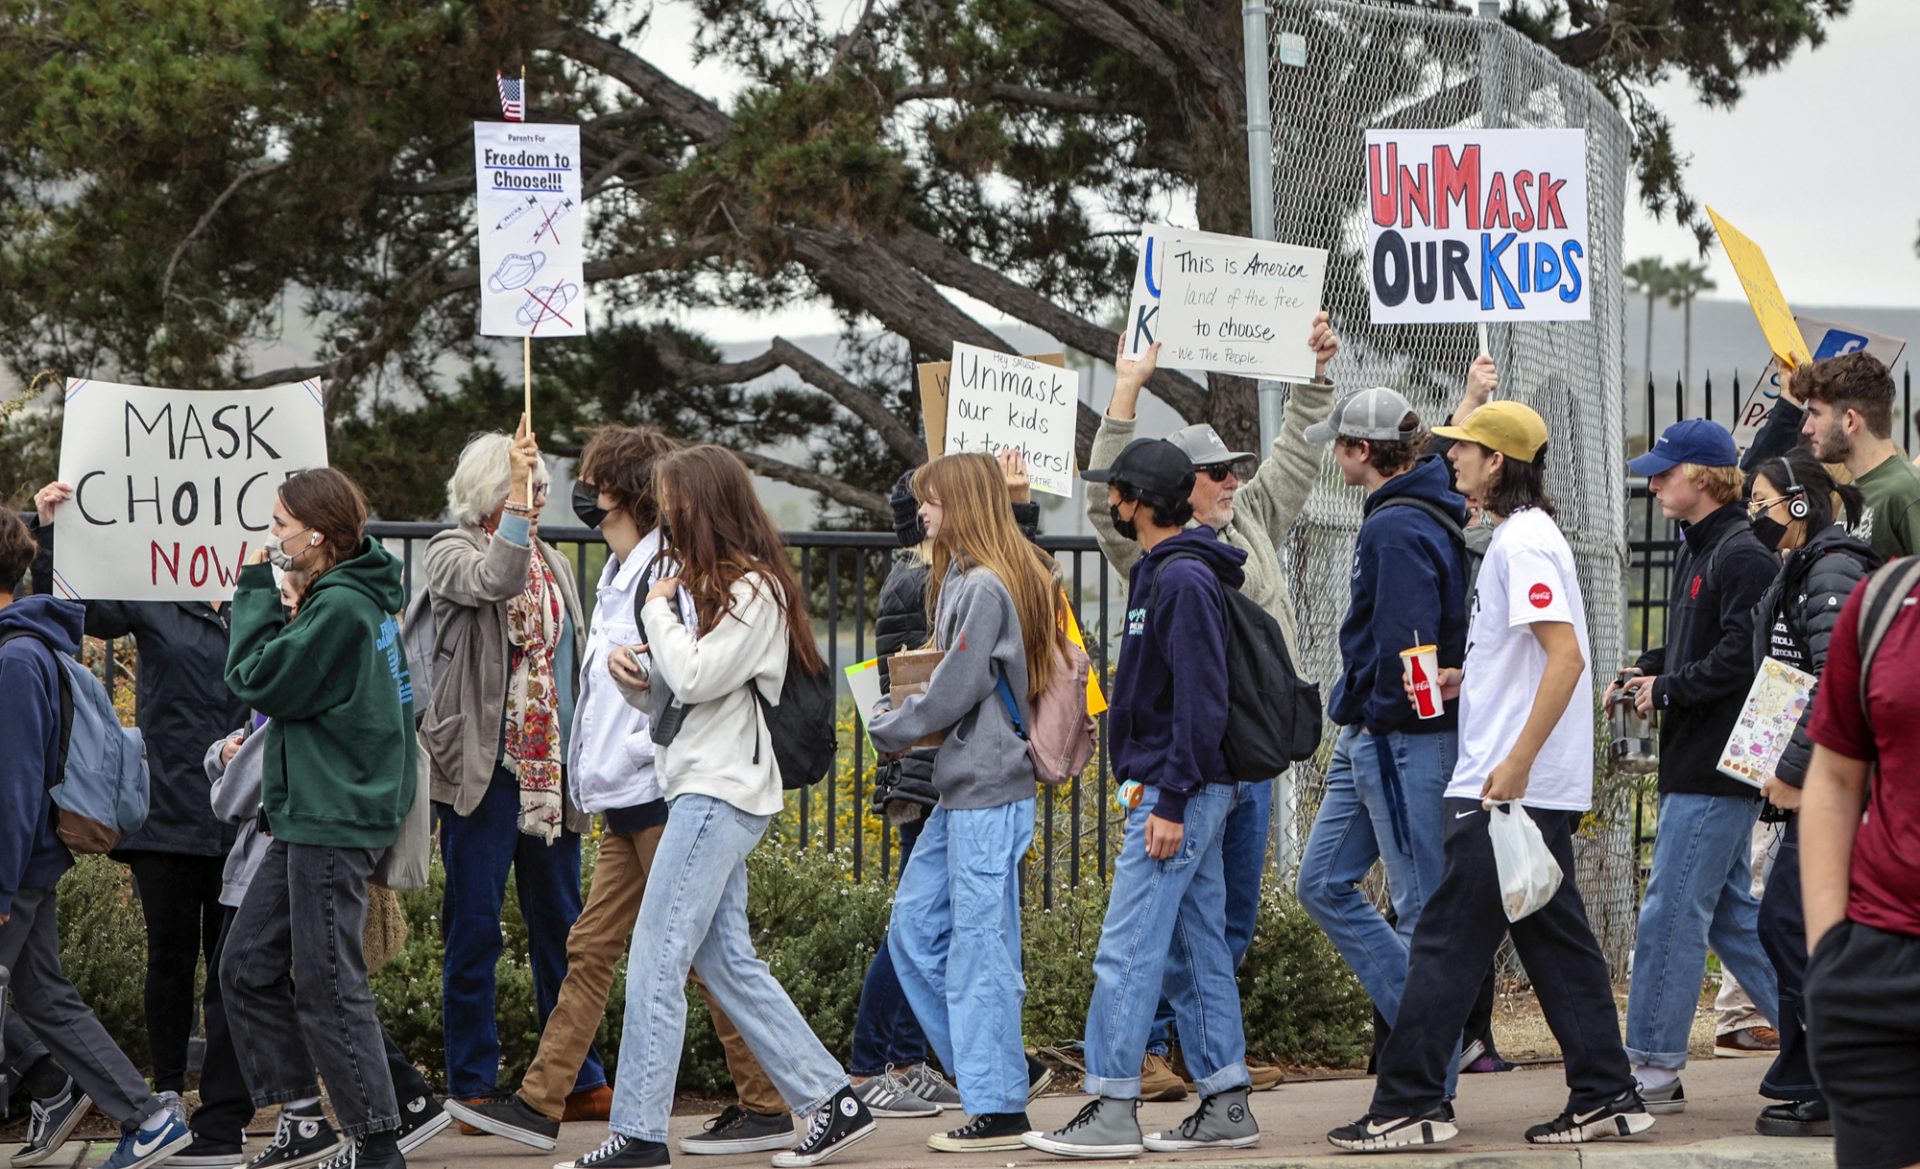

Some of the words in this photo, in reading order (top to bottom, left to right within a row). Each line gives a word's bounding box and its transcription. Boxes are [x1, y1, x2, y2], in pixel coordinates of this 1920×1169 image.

[508, 134, 533, 143] Parents
[535, 134, 546, 143] For
[484, 148, 549, 168] Freedom
[554, 152, 570, 168] to
[494, 170, 562, 191] Choose!!!
[1174, 250, 1214, 274] This
[1225, 257, 1238, 274] is
[1243, 252, 1308, 278] America
[1372, 229, 1478, 307] OUR
[1480, 232, 1583, 310] KIDS
[1183, 282, 1218, 306] land
[1227, 292, 1241, 310] of
[1245, 288, 1268, 306] the
[1274, 286, 1304, 310] free
[1193, 318, 1210, 337] to
[1219, 317, 1276, 341] choose
[1199, 347, 1218, 362] The
[961, 352, 1066, 406] Unmask
[125, 400, 282, 460] MASK
[958, 398, 993, 421] our
[1008, 402, 1048, 434] kids
[980, 432, 1070, 475] tehers!
[151, 539, 248, 588] NOW
